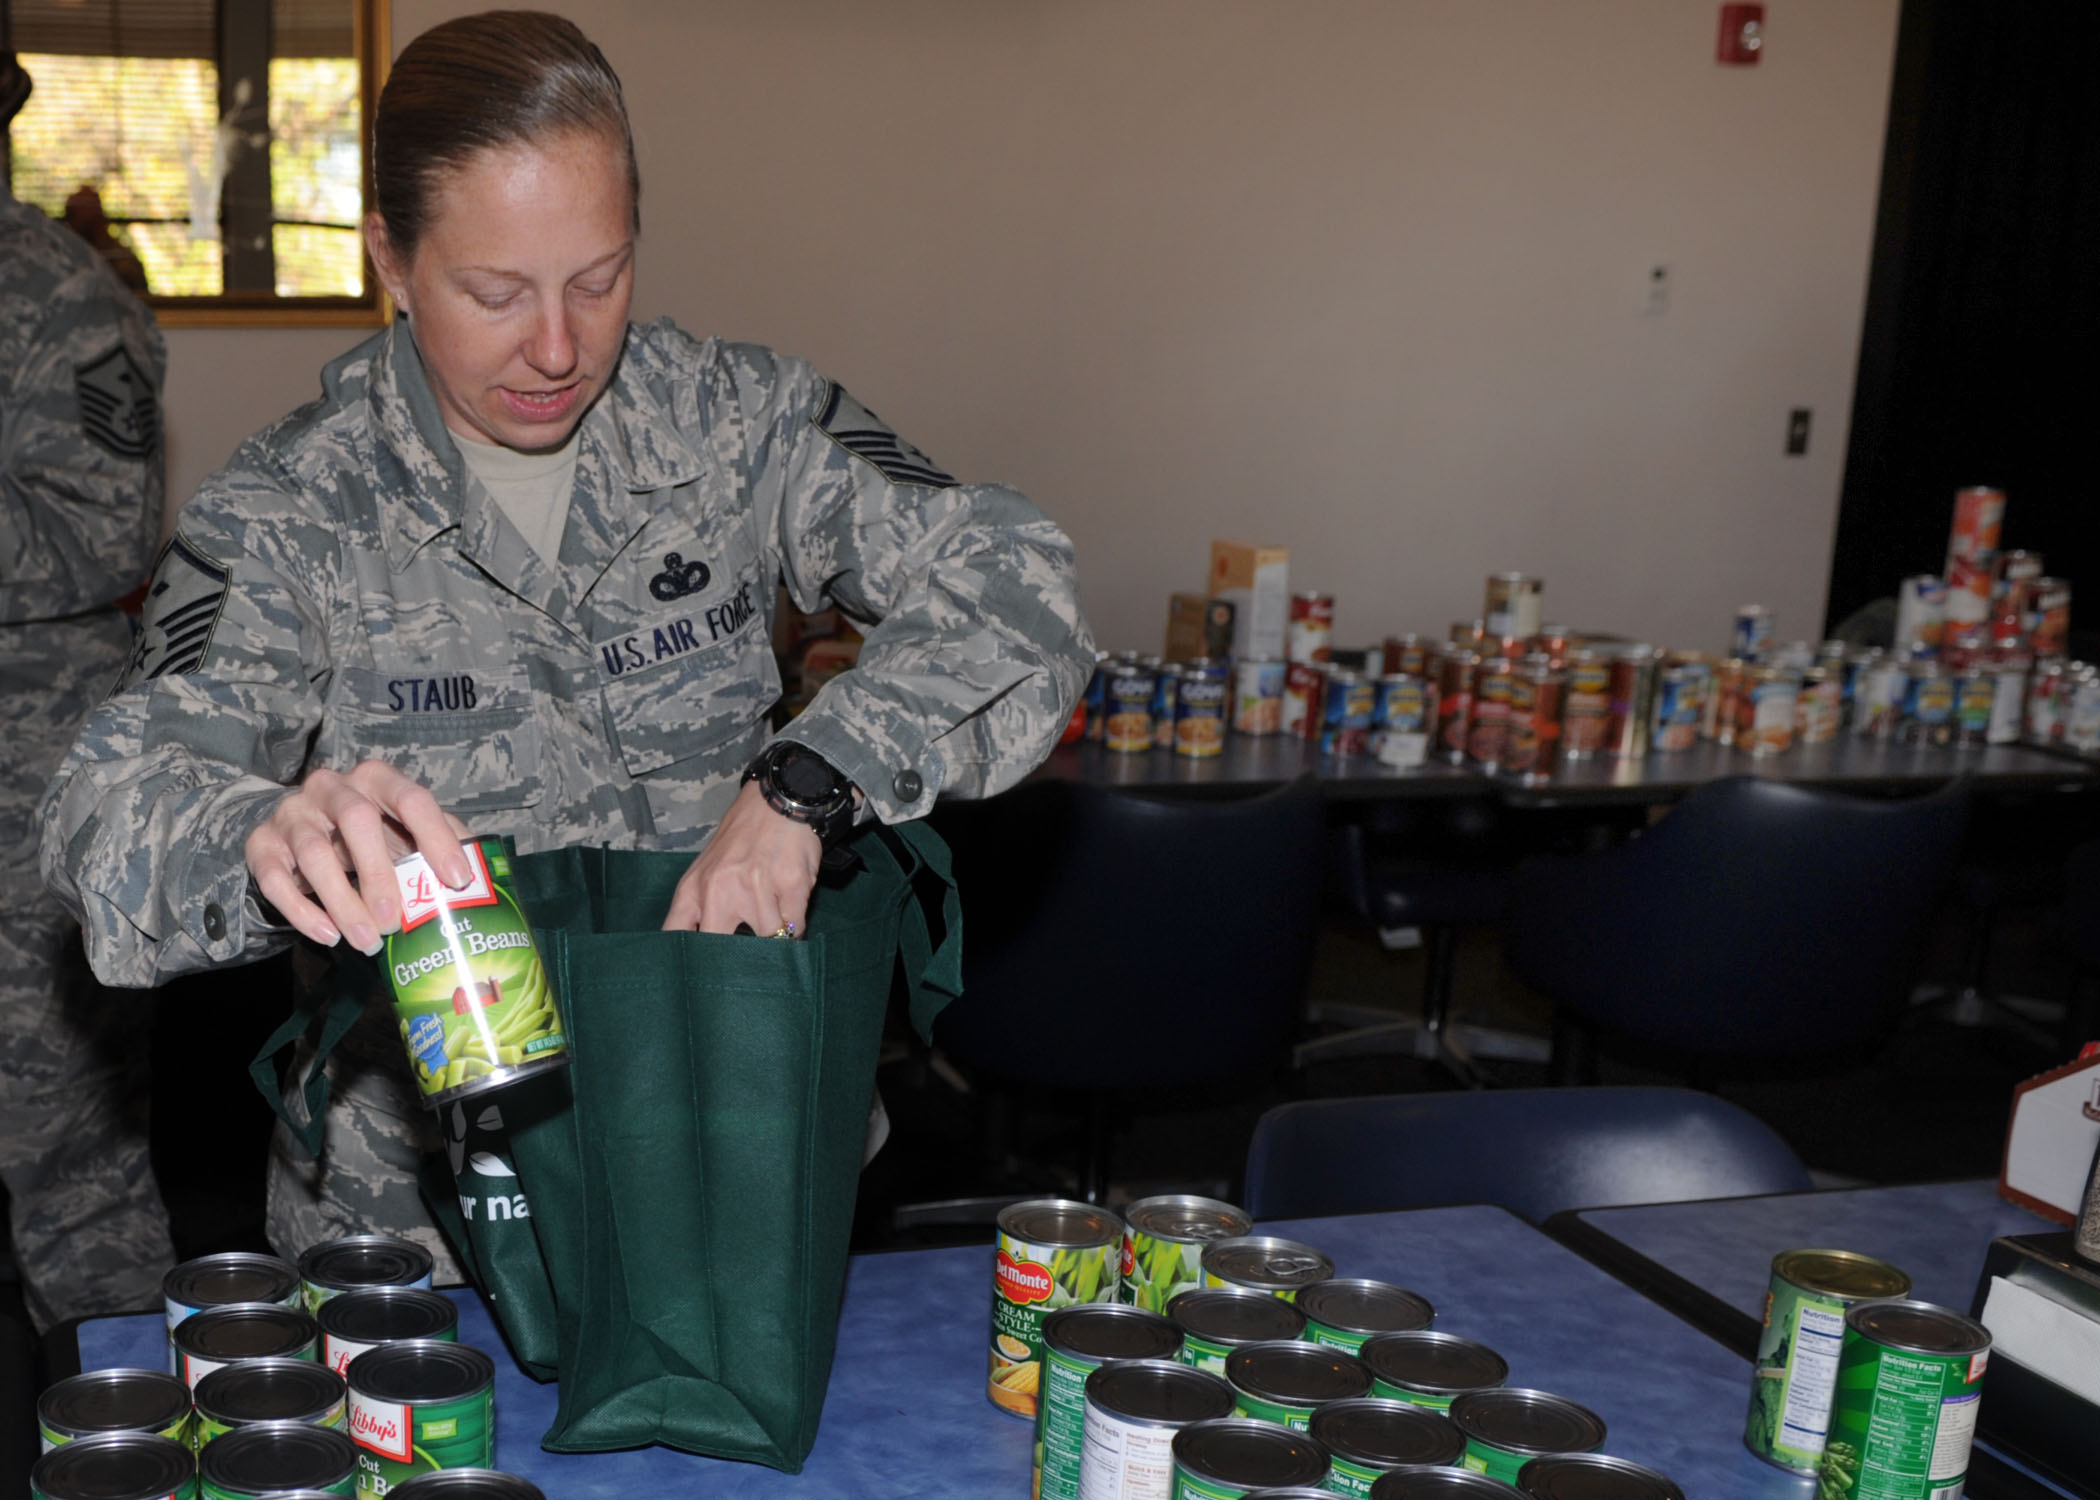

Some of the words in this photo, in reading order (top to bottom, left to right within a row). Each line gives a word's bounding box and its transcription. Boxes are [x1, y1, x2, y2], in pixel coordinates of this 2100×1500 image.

[602, 637, 652, 676] U.S.
[655, 618, 699, 660] AIR
[705, 582, 757, 640] FORCE
[387, 675, 478, 712] STAUB
[465, 930, 530, 957] Beans
[487, 1193, 530, 1221] na
[1008, 1266, 1049, 1290] Monte
[998, 1300, 1036, 1323] CREAM
[999, 1311, 1032, 1333] STYLE
[1029, 1333, 1043, 1344] Co
[351, 1403, 398, 1441] Libby's
[359, 1454, 380, 1474] Cut
